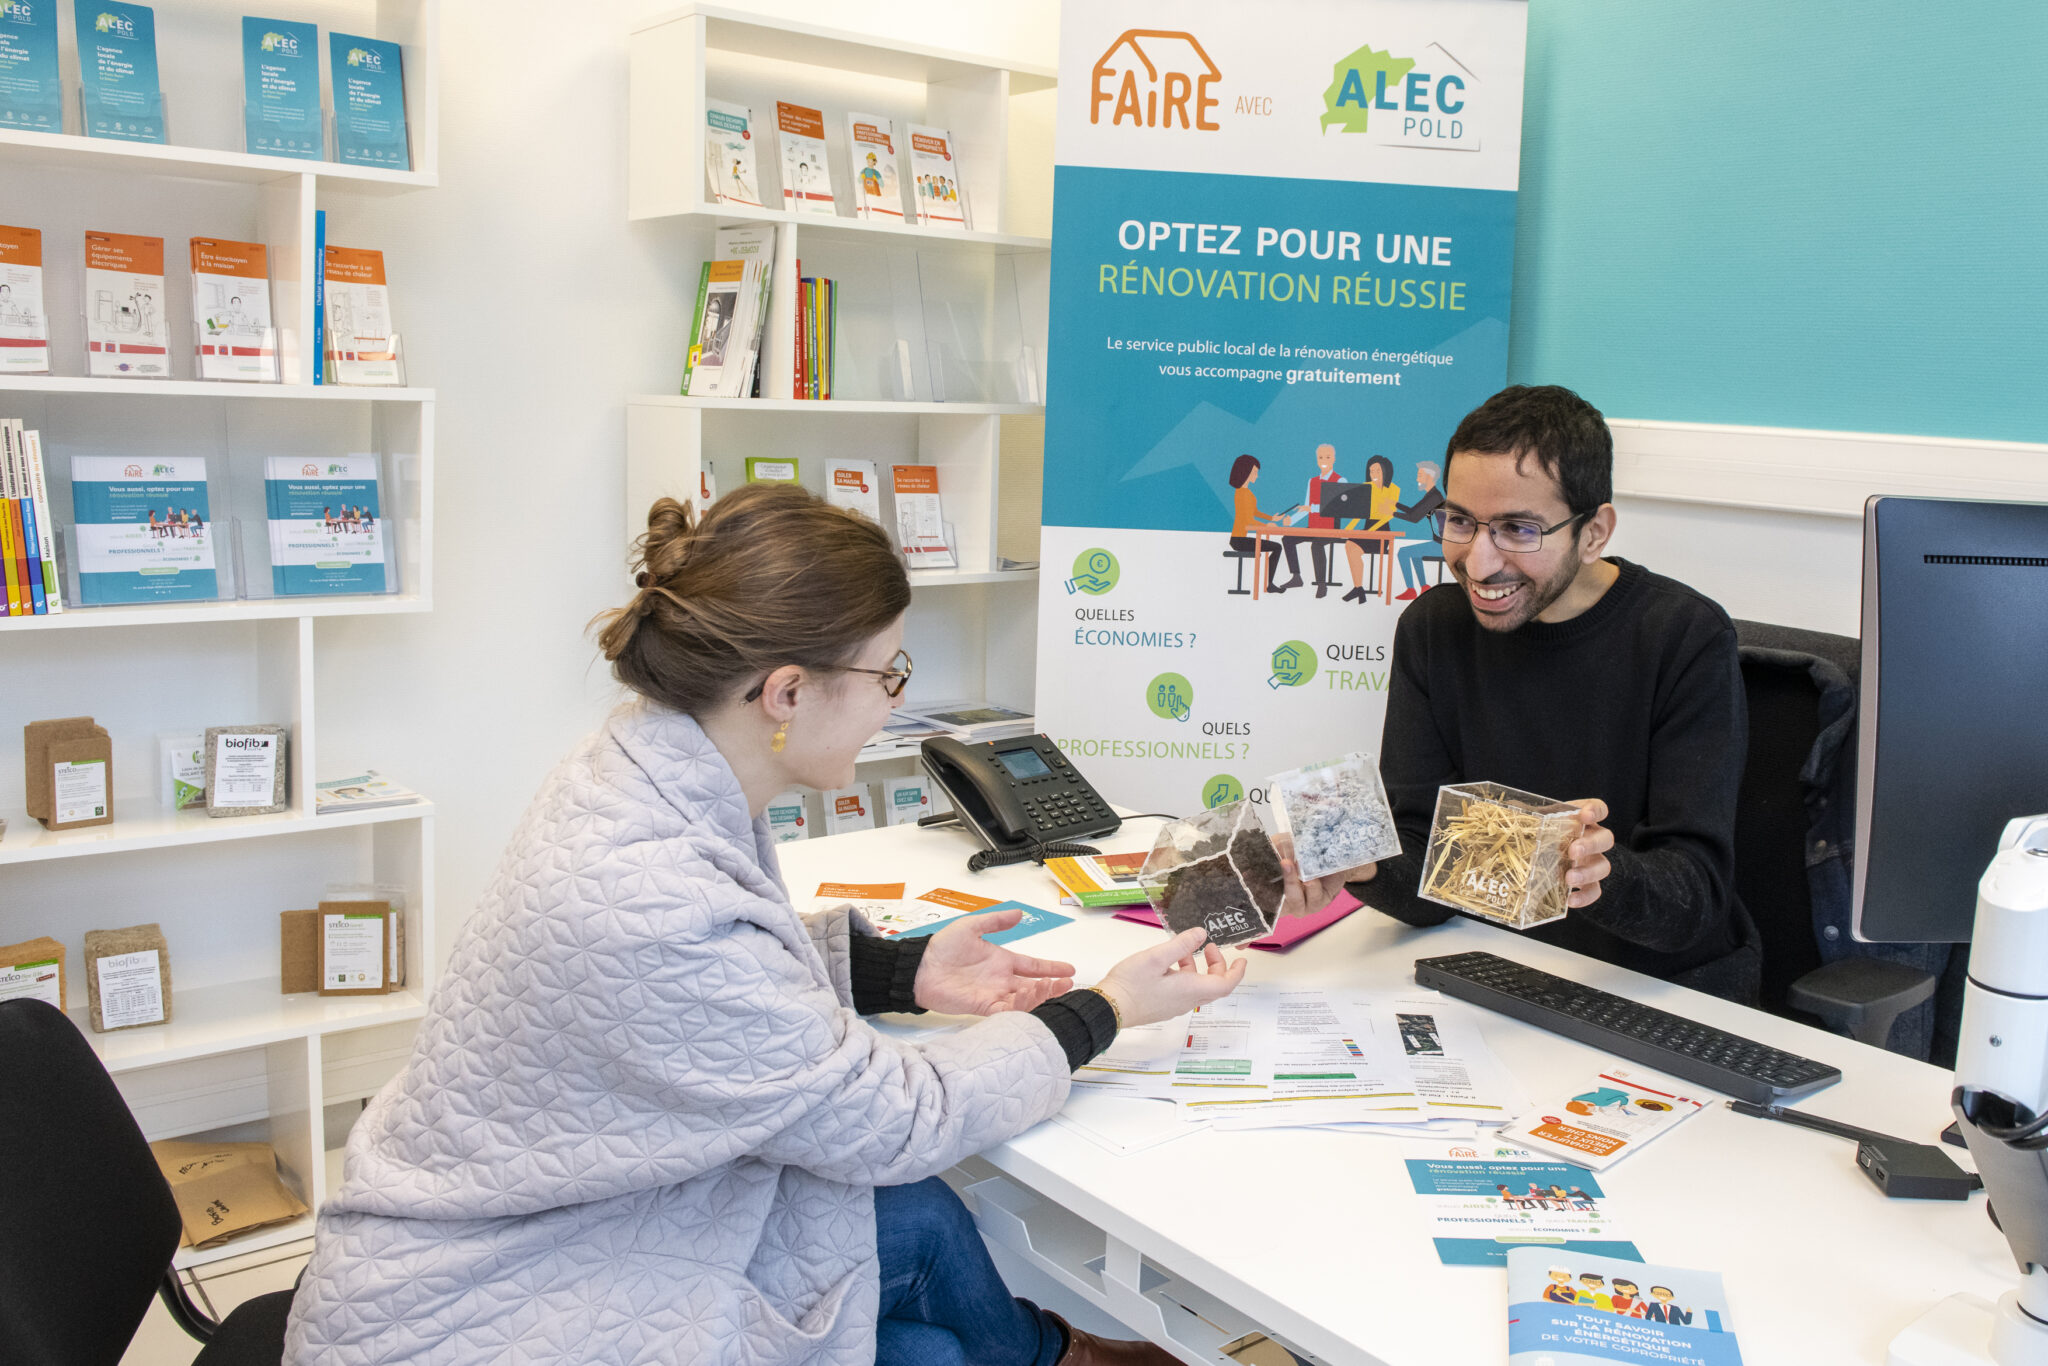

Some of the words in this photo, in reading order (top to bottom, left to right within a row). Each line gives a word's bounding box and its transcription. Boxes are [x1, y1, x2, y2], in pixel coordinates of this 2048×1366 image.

[0, 4, 31, 16] LEC
[98, 17, 133, 31] ALEC
[264, 37, 298, 49] ALEC
[350, 52, 381, 65] ALEC
[1335, 68, 1466, 115] ALEC
[1234, 96, 1272, 116] AVEC
[1403, 117, 1463, 139] POLD
[1118, 219, 1241, 255] OPTEZ
[1256, 226, 1361, 262] POUR
[1376, 233, 1452, 267] UNE
[91, 252, 133, 263] équipements
[213, 262, 235, 270] maison
[1099, 259, 1320, 304] RÉNOVATION
[1332, 272, 1467, 311] RÉUSSIE
[1107, 337, 1123, 350] Le
[1126, 339, 1174, 352] service
[1177, 339, 1221, 357] public
[1223, 340, 1255, 356] local
[1258, 342, 1276, 357] de
[1279, 343, 1291, 358] la
[1294, 344, 1368, 361] rénovation
[1371, 348, 1454, 367] énergétique
[1159, 365, 1191, 377] vous
[1194, 366, 1283, 383] accompagne
[1286, 366, 1401, 386] gratuitement
[1075, 608, 1135, 621] QUELLES
[1075, 627, 1183, 648] ÉCONOMIES
[1189, 633, 1197, 648] ?
[1326, 644, 1385, 661] QUELS
[1202, 721, 1251, 736] QUELS
[1057, 739, 1235, 760] PROFESSIONNELS
[1241, 743, 1250, 760] ?
[1466, 873, 1510, 898] ALEC
[1486, 894, 1507, 906] POLD
[1208, 911, 1246, 932] ALEC
[1230, 923, 1250, 933] POLD
[0, 974, 20, 983] TEICO
[1557, 1125, 1586, 1138] CHER
[1566, 1134, 1578, 1142] ET
[1585, 1131, 1618, 1145] MOINS
[1537, 1131, 1589, 1150] CHAUFFER
[1578, 1137, 1613, 1150] MIEUX
[1590, 1145, 1606, 1155] SE
[1551, 1318, 1579, 1328] SUR
[1582, 1323, 1600, 1331] LA
[1604, 1325, 1692, 1349] RÉNOVATION
[1576, 1314, 1611, 1326] TOUT
[1615, 1321, 1665, 1337] SAVOIR
[1541, 1333, 1560, 1341] DE
[1563, 1335, 1608, 1348] VOTRE
[1612, 1343, 1706, 1366] COPROPRIÉTÉ
[1574, 1329, 1670, 1354] ÉNERGÉTIQUE
